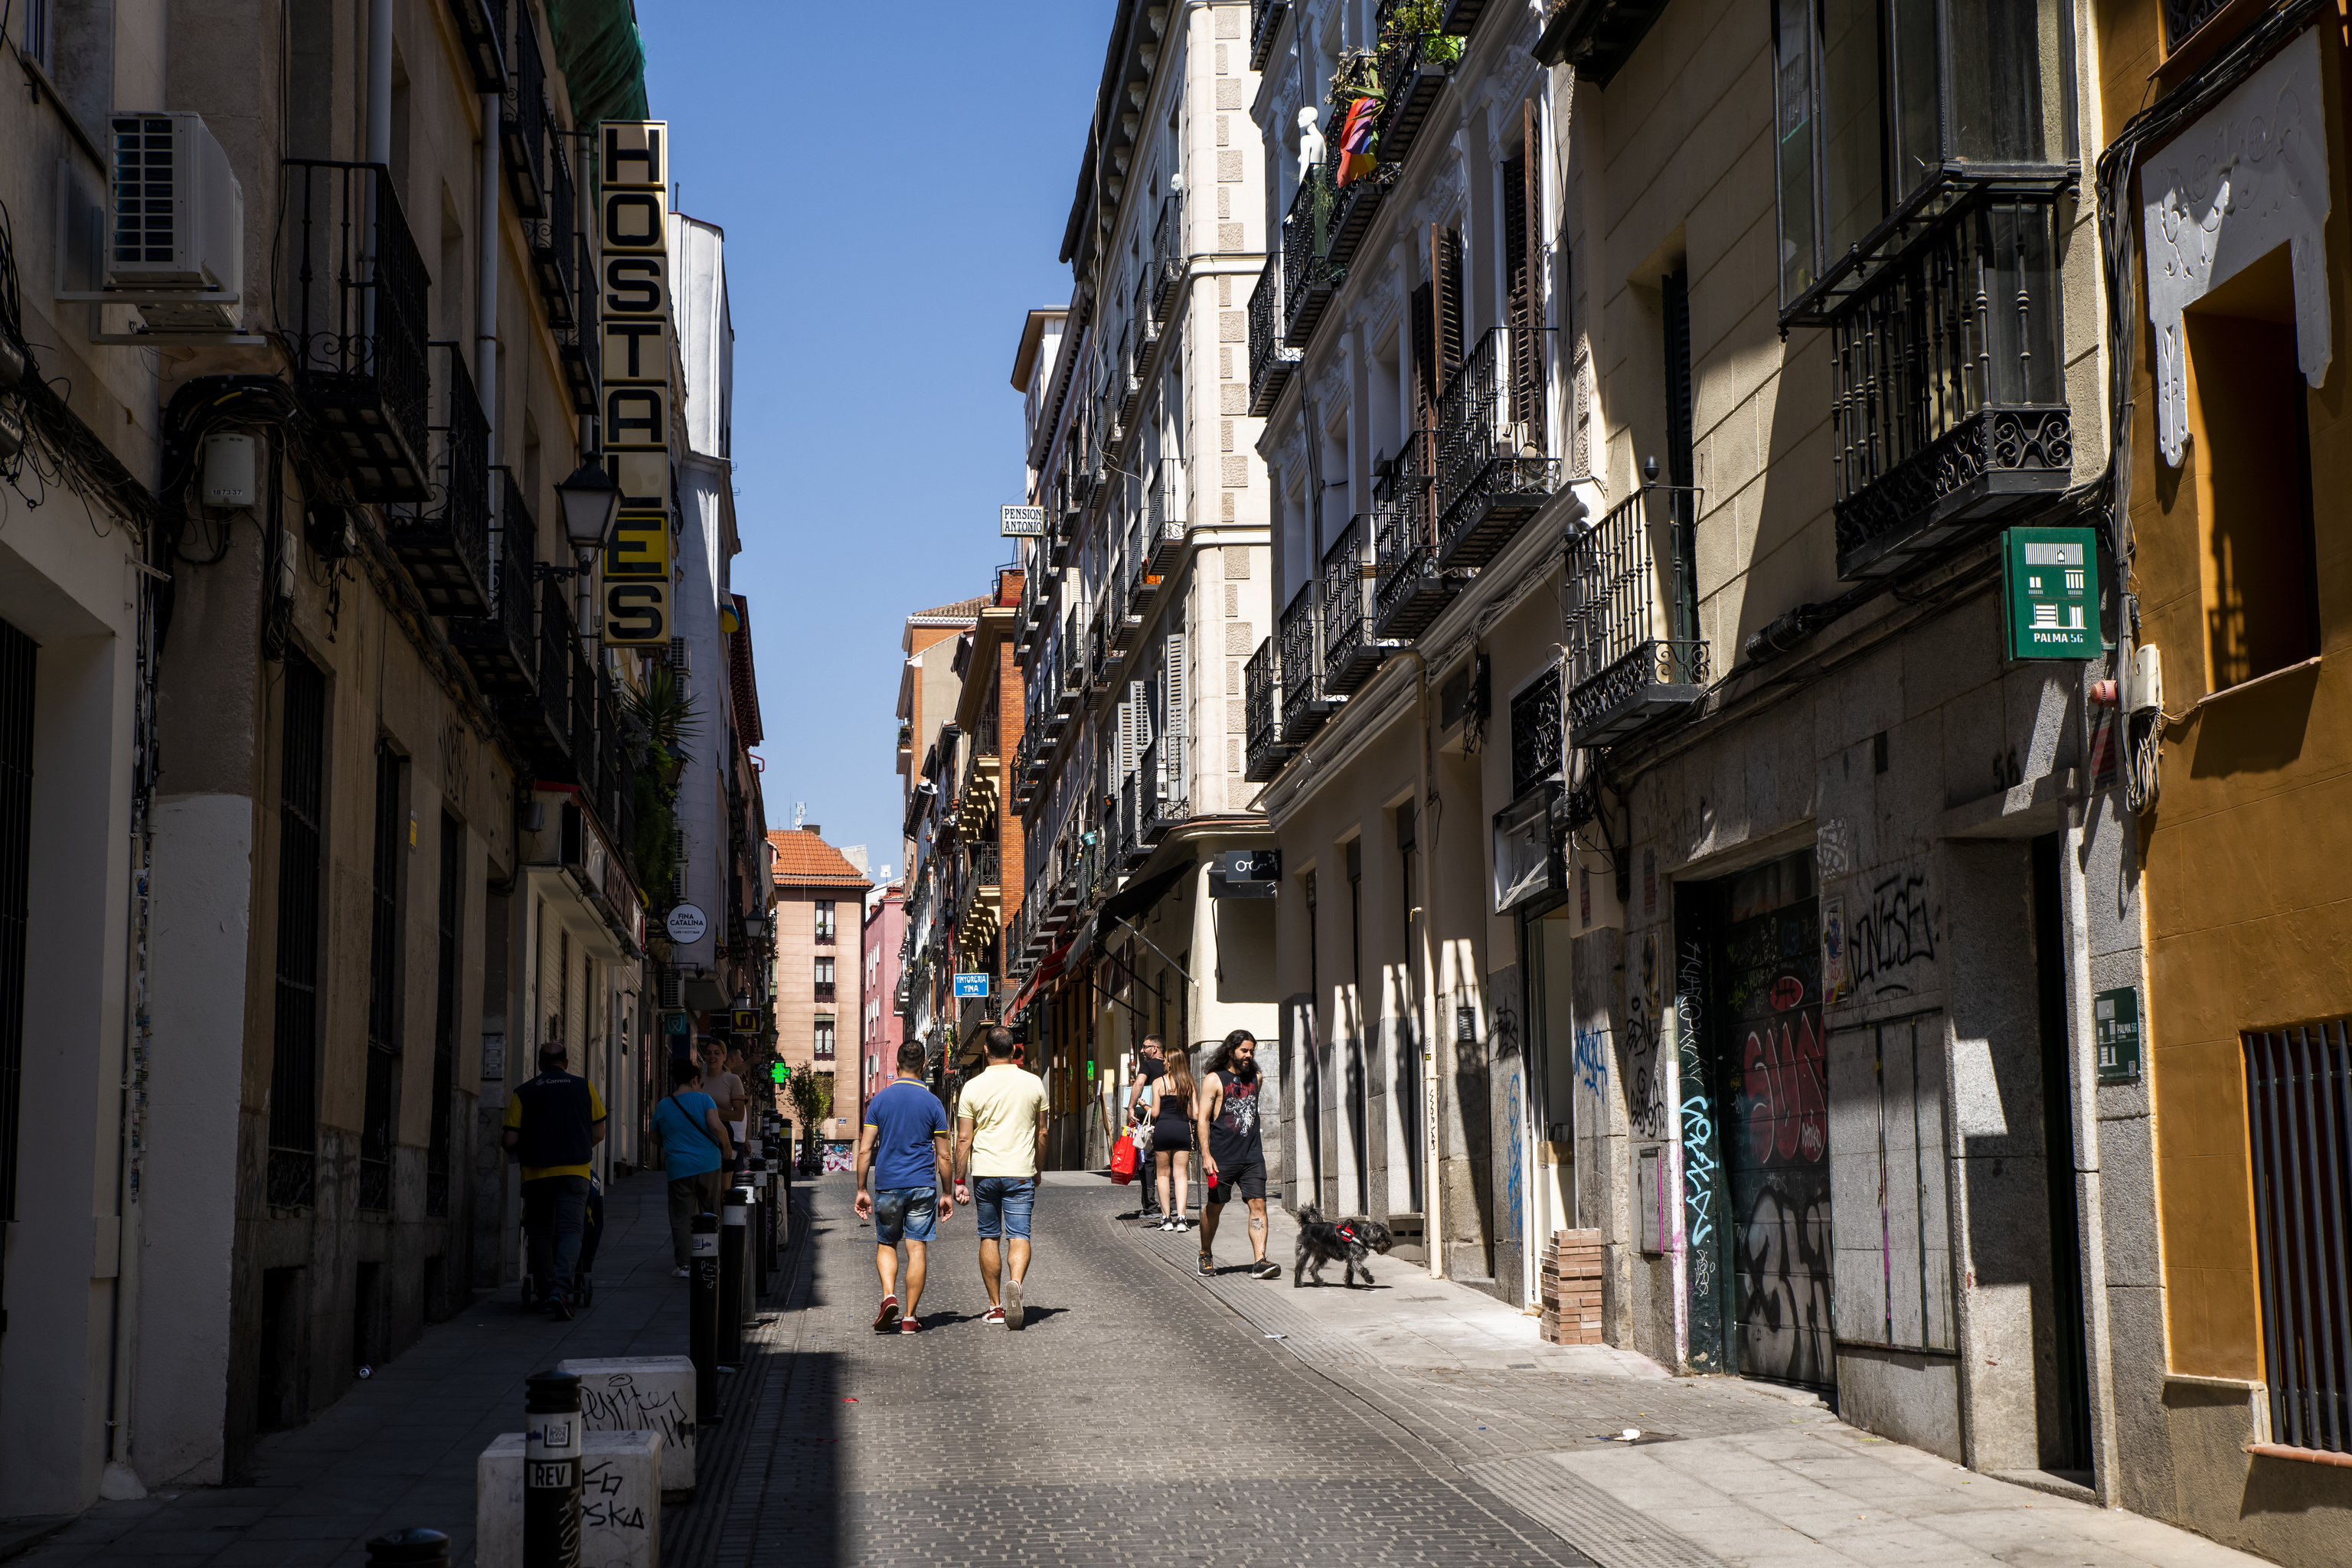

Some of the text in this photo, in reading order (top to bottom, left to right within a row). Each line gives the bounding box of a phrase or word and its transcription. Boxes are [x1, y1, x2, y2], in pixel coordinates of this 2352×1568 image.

[606, 127, 663, 641] HOSTALES
[1004, 508, 1042, 520] PENSION
[1004, 521, 1042, 532] ANTONIO
[2034, 632, 2069, 643] PALMA
[1992, 749, 2020, 793] 56
[956, 975, 986, 984] TINTORERIA
[963, 985, 979, 993] TINA
[2117, 1023, 2132, 1034] PALMA
[535, 1465, 566, 1486] REV
